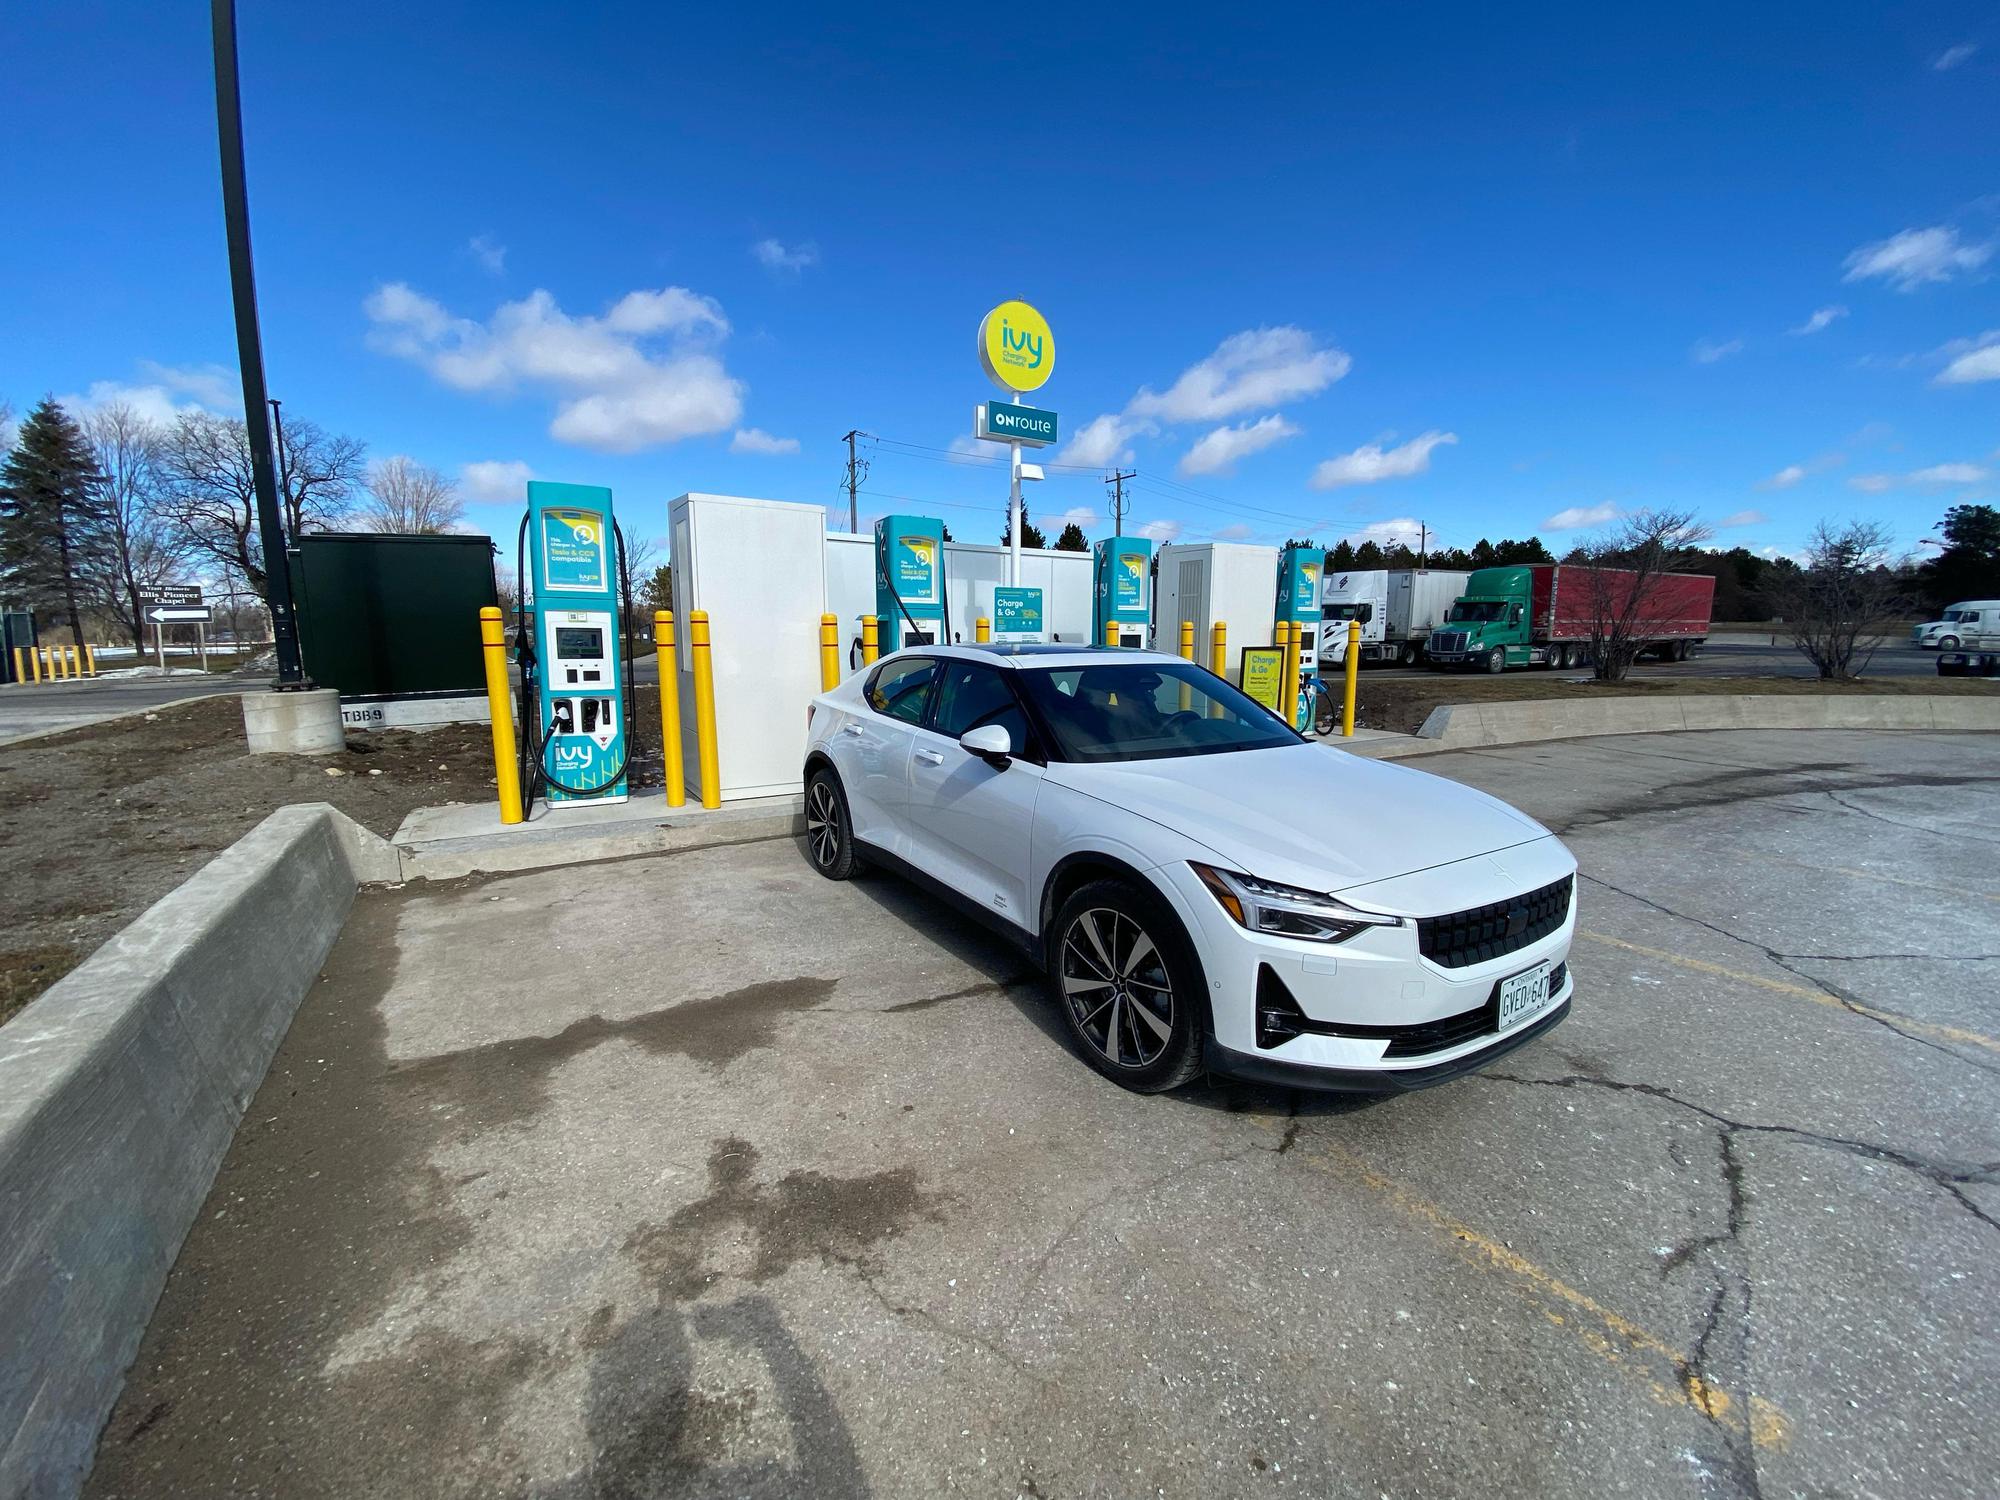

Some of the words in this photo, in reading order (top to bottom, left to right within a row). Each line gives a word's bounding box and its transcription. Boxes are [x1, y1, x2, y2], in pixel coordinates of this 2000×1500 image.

[1003, 318, 1042, 369] ivy
[996, 413, 1051, 433] ONroute
[163, 591, 199, 599] Pioneer
[154, 597, 186, 605] Chapel
[997, 598, 1024, 609] Charge
[997, 608, 1004, 616] &
[1004, 608, 1016, 616] Go
[1251, 655, 1277, 666] Charge
[1258, 665, 1268, 673] Go
[555, 742, 592, 769] ivy
